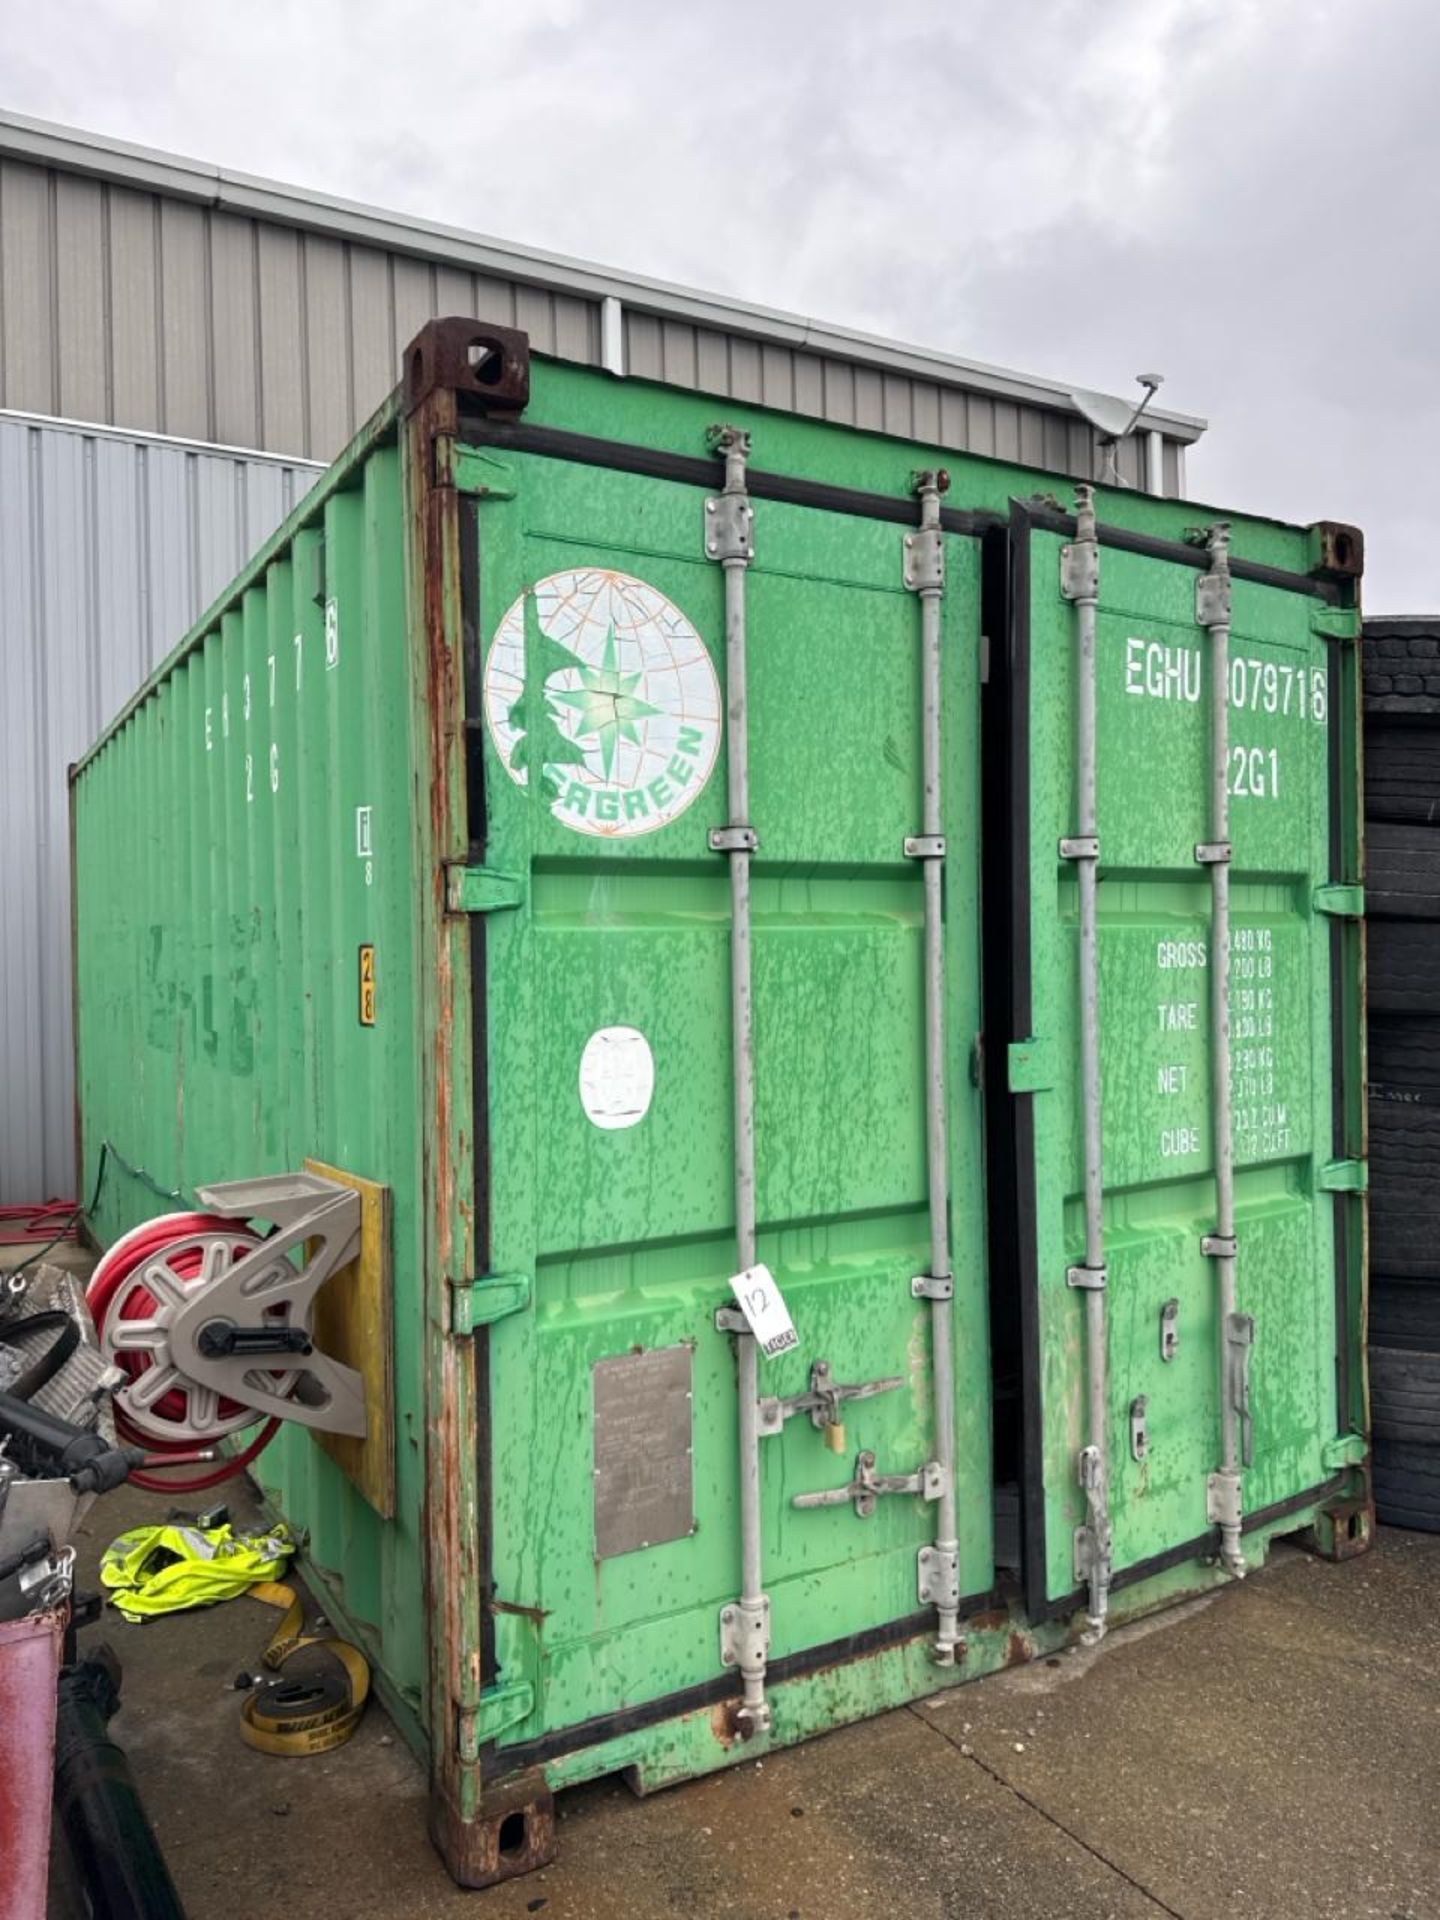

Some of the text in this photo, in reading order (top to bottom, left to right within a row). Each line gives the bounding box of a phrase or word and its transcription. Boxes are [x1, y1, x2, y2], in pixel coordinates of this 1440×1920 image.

[1126, 637, 1326, 721] EGHU 079716
[1226, 746, 1279, 798] 2G1
[1156, 941, 1208, 969] GROSS
[1157, 1002, 1198, 1033] TARE
[1157, 1065, 1189, 1094] NET
[1161, 1127, 1202, 1157] CUBE
